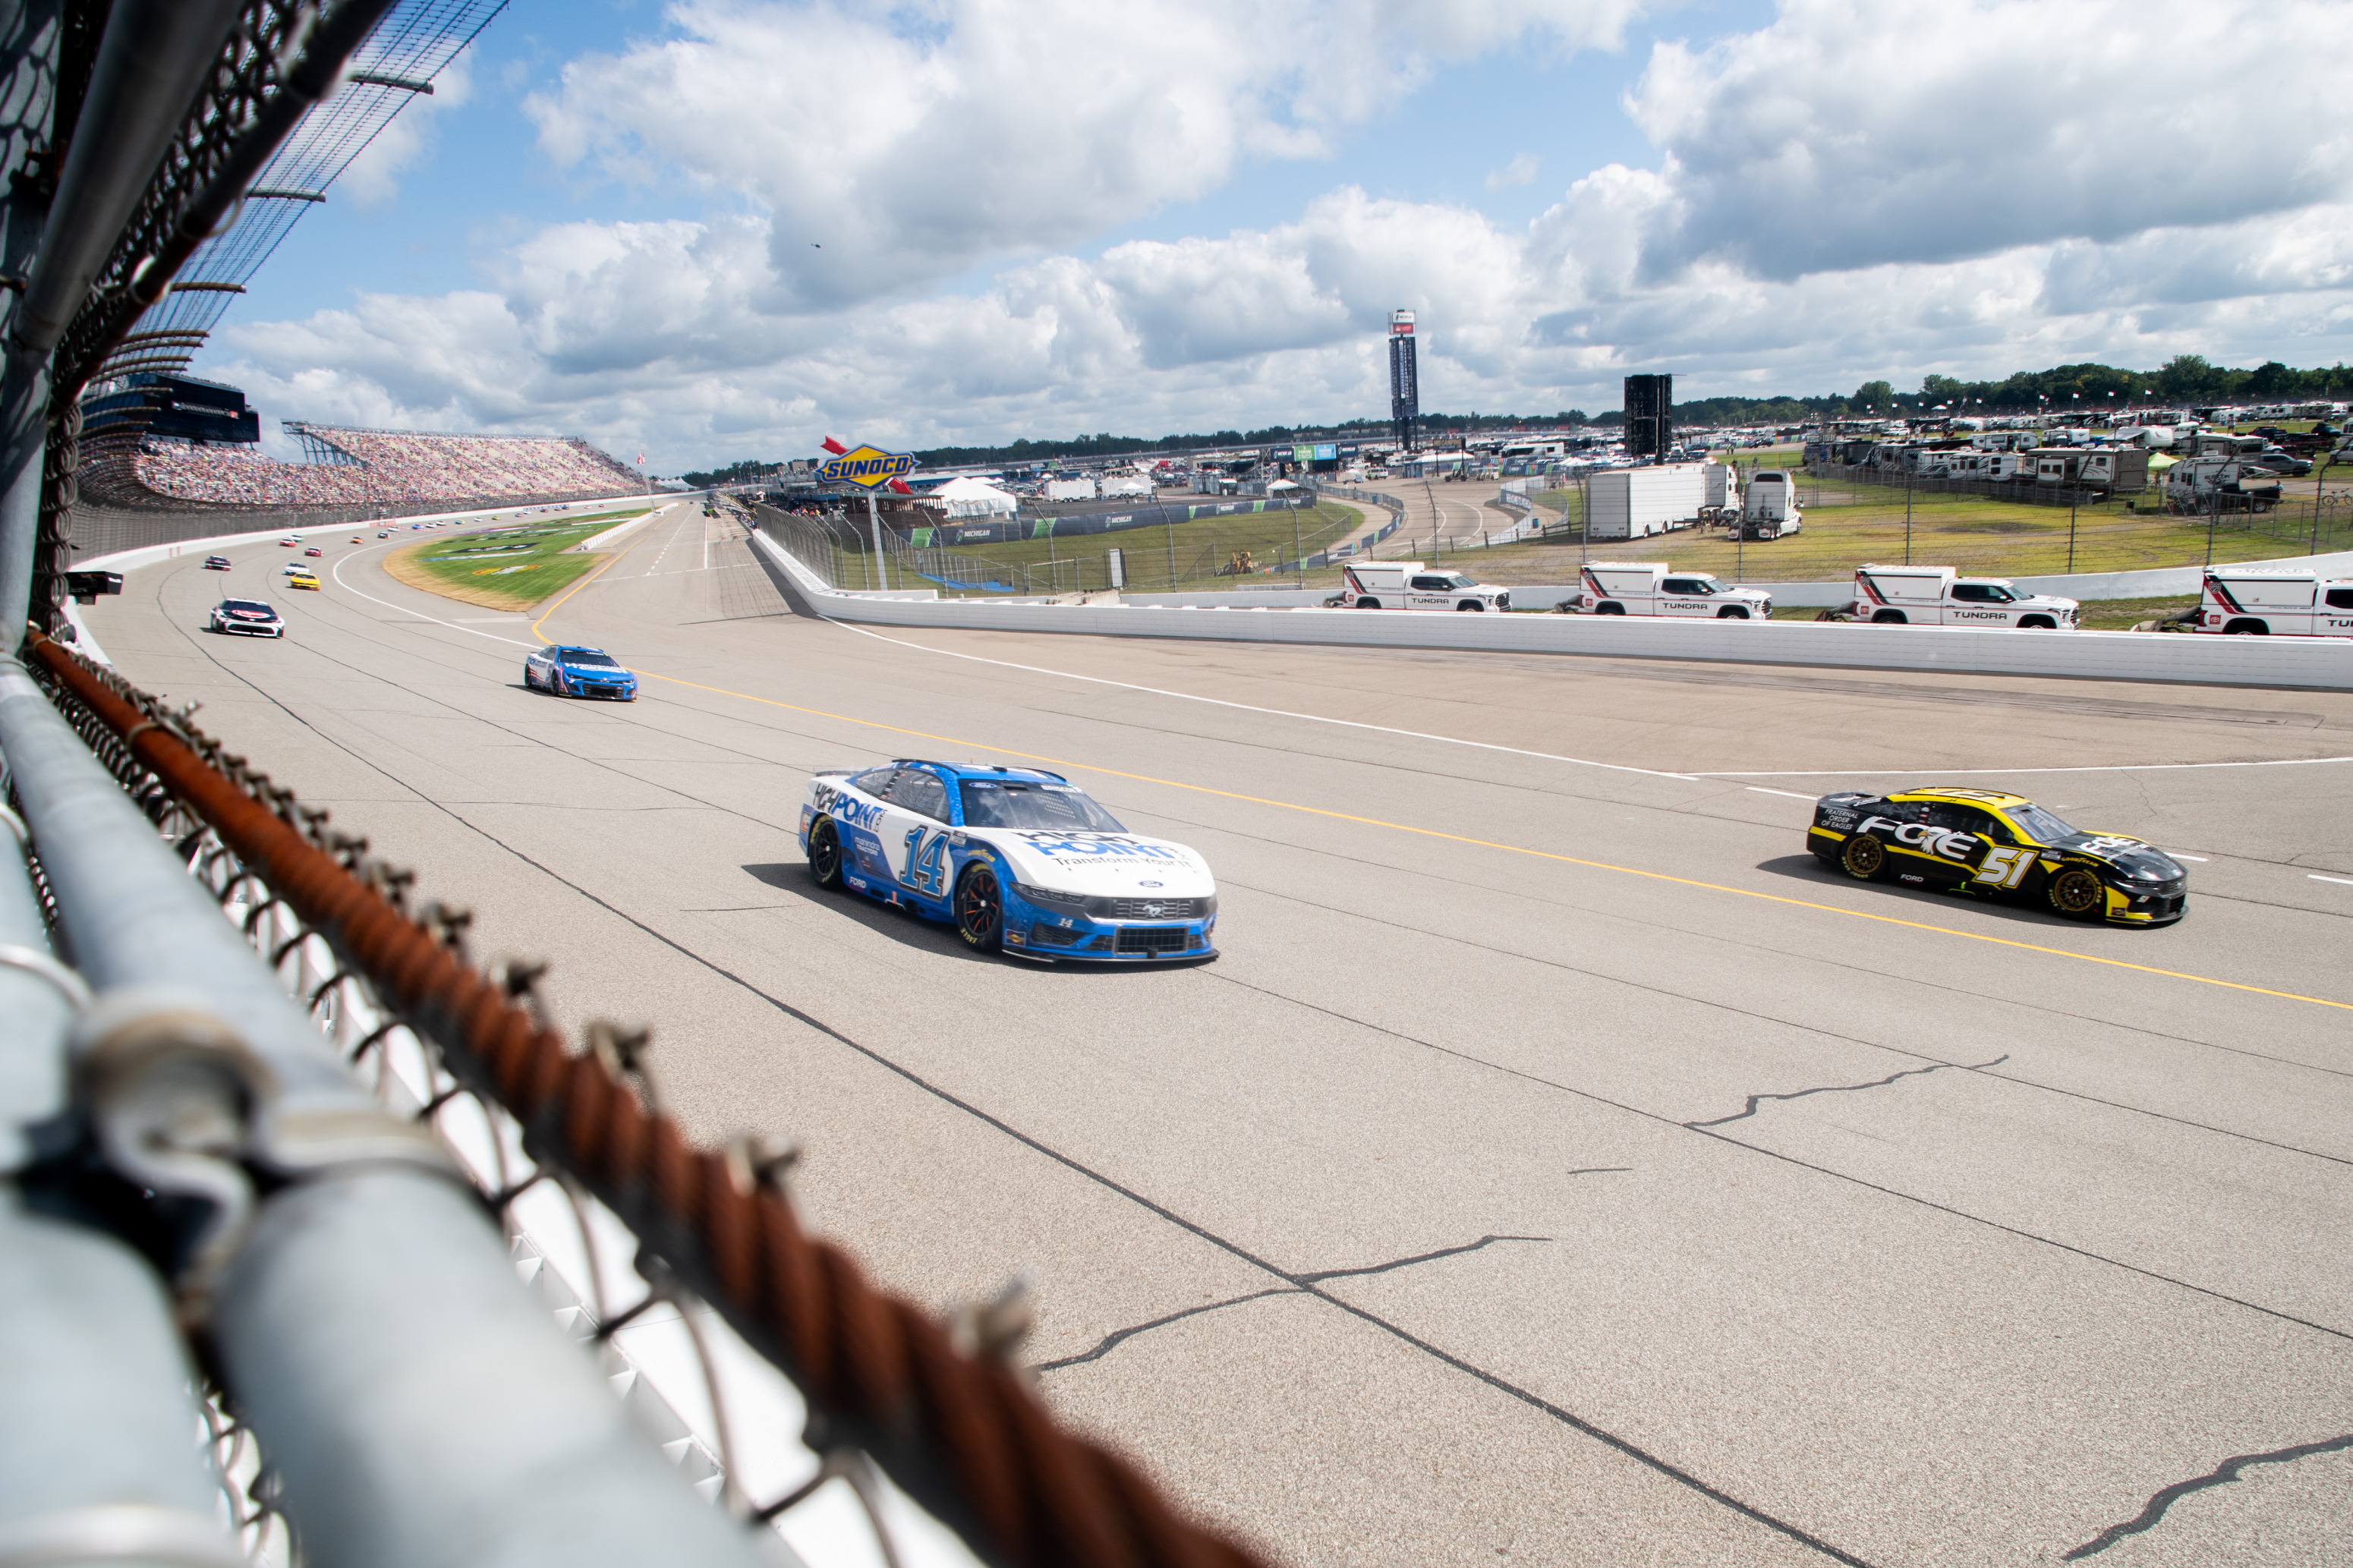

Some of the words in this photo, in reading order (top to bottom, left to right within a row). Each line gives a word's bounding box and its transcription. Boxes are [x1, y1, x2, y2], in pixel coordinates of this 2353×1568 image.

[827, 456, 909, 477] SUNOCO
[1110, 515, 1132, 524] MICHIGAN
[963, 529, 991, 538] MICHIGAN
[1953, 611, 2008, 620] TUNDRA
[1825, 808, 1860, 819] FRATERNAL
[1829, 815, 1851, 823] ORDER
[1831, 822, 1854, 830] EAGLES
[855, 836, 880, 851] mahindra
[899, 823, 952, 903] 14
[1051, 857, 1139, 867] Transform
[1144, 858, 1176, 867] Your
[1177, 861, 1193, 869] IT
[1971, 844, 2041, 889] 51
[2060, 856, 2100, 867] GOODYEAR
[849, 876, 867, 889] FORD
[1900, 874, 1925, 883] FORD
[2136, 895, 2151, 903] 51
[1057, 917, 1075, 929] 14
